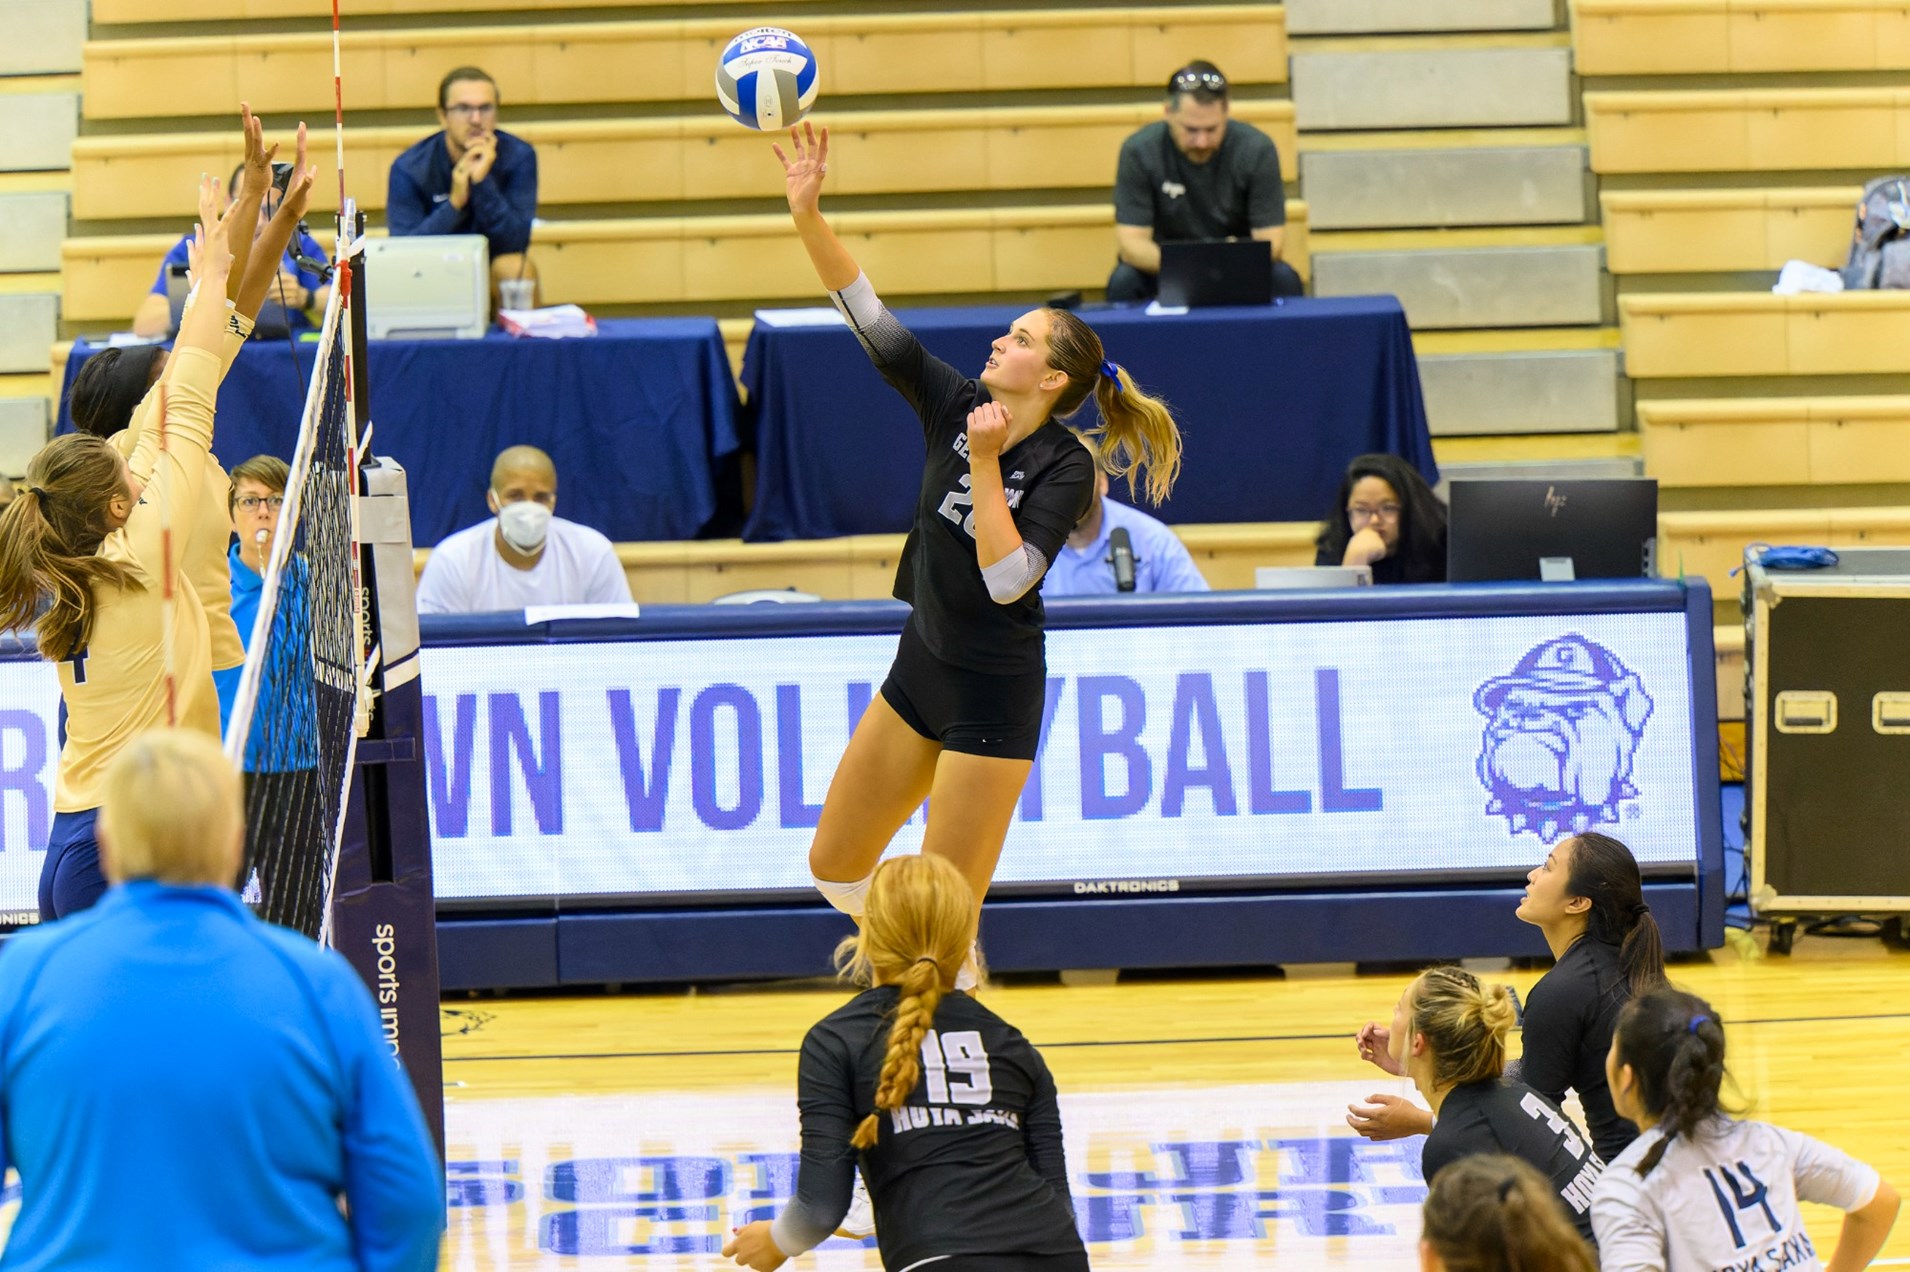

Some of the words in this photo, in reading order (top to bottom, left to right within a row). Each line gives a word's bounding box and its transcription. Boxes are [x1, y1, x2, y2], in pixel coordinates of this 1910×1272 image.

[740, 35, 788, 54] NCAA
[606, 668, 1383, 832] VOLYBALL
[1074, 879, 1180, 894] DAKTRONICS
[371, 923, 400, 1004] sports
[920, 1029, 993, 1105] 19
[1520, 1091, 1585, 1160] 3
[1702, 1160, 1782, 1250] 14
